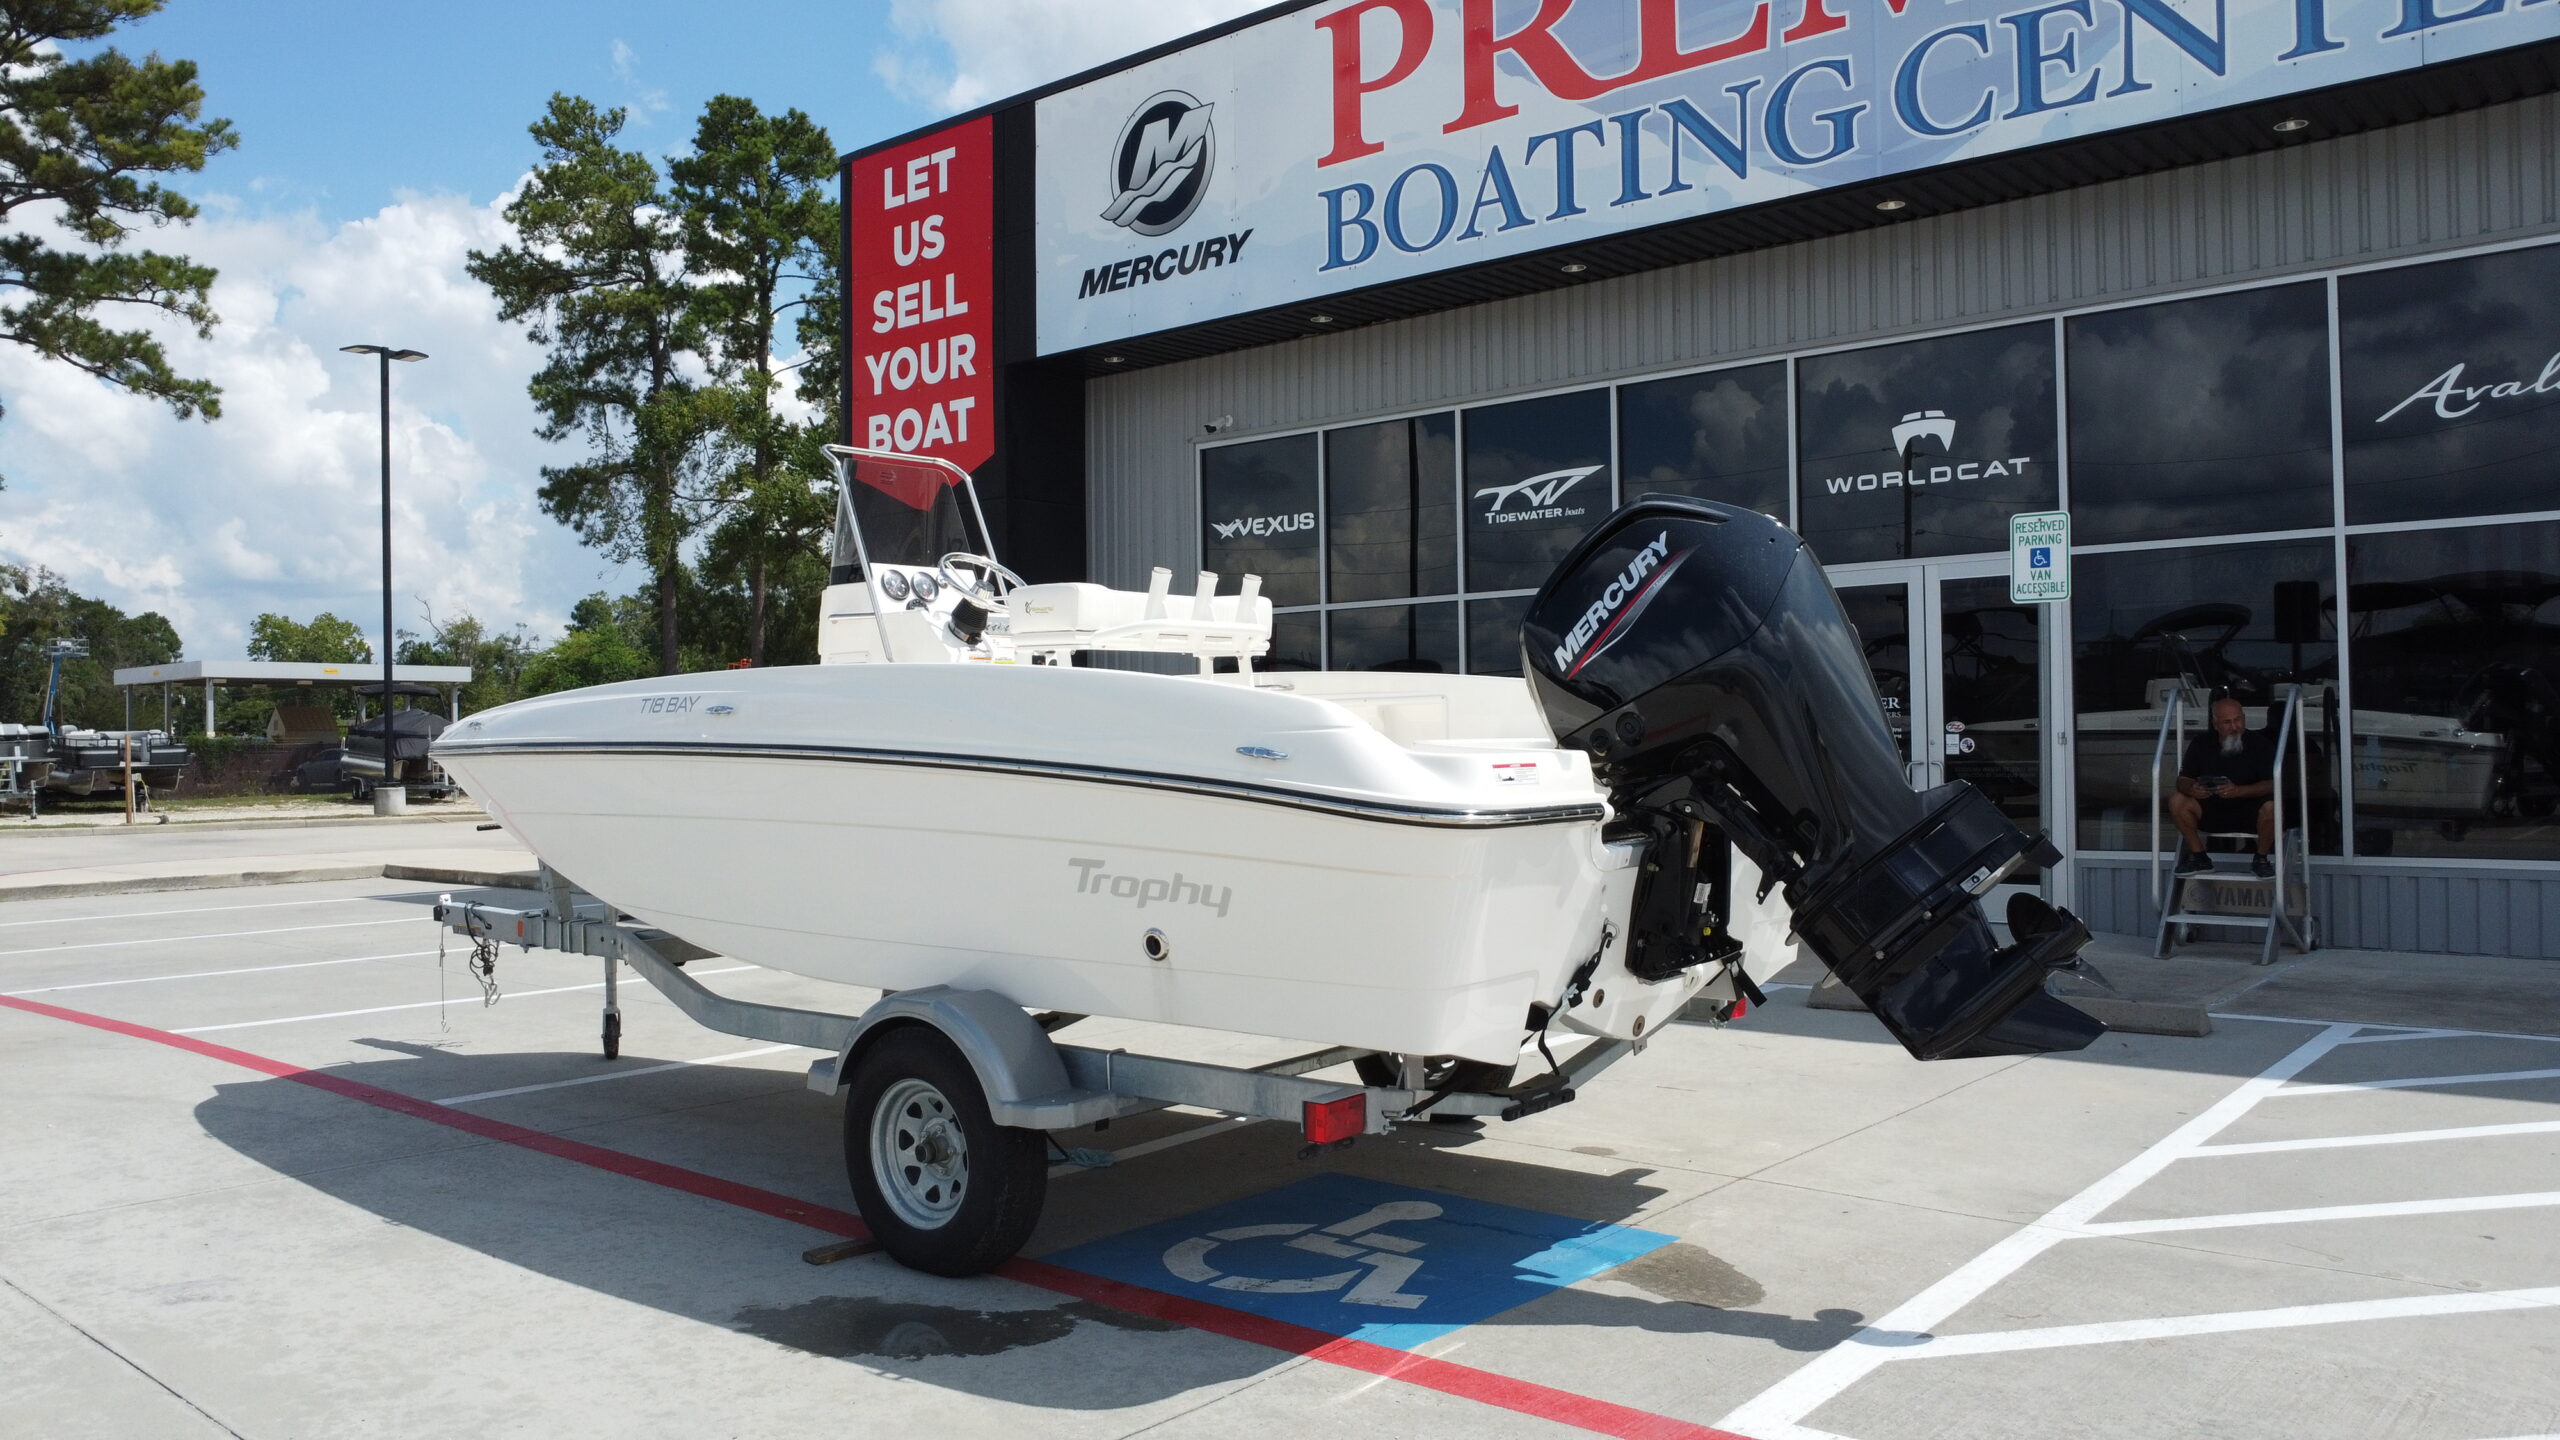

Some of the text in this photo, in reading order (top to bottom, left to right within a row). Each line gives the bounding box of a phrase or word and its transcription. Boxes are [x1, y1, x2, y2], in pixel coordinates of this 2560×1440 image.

[1315, 0, 1912, 168] PRE
[1318, 0, 2560, 273] BOATING CEN
[883, 147, 957, 210] LET
[893, 214, 945, 268] US
[1078, 228, 1254, 299] MERCURY
[872, 273, 969, 334] SELL
[864, 333, 977, 396] YOUR
[867, 396, 976, 457] BOAT
[1826, 457, 2030, 494] WORLDCAT
[1235, 512, 1315, 537] VEXUS
[1484, 507, 1562, 525] TIDEWATER
[2015, 520, 2065, 534] RESERVED
[2018, 533, 2062, 546] PARKING
[1553, 530, 1669, 673] MERCURY
[2016, 581, 2066, 595] ACCESSIBLE
[2030, 569, 2052, 581] VAN
[640, 695, 701, 714] T18 BAY
[1068, 857, 1232, 918] Trophy
